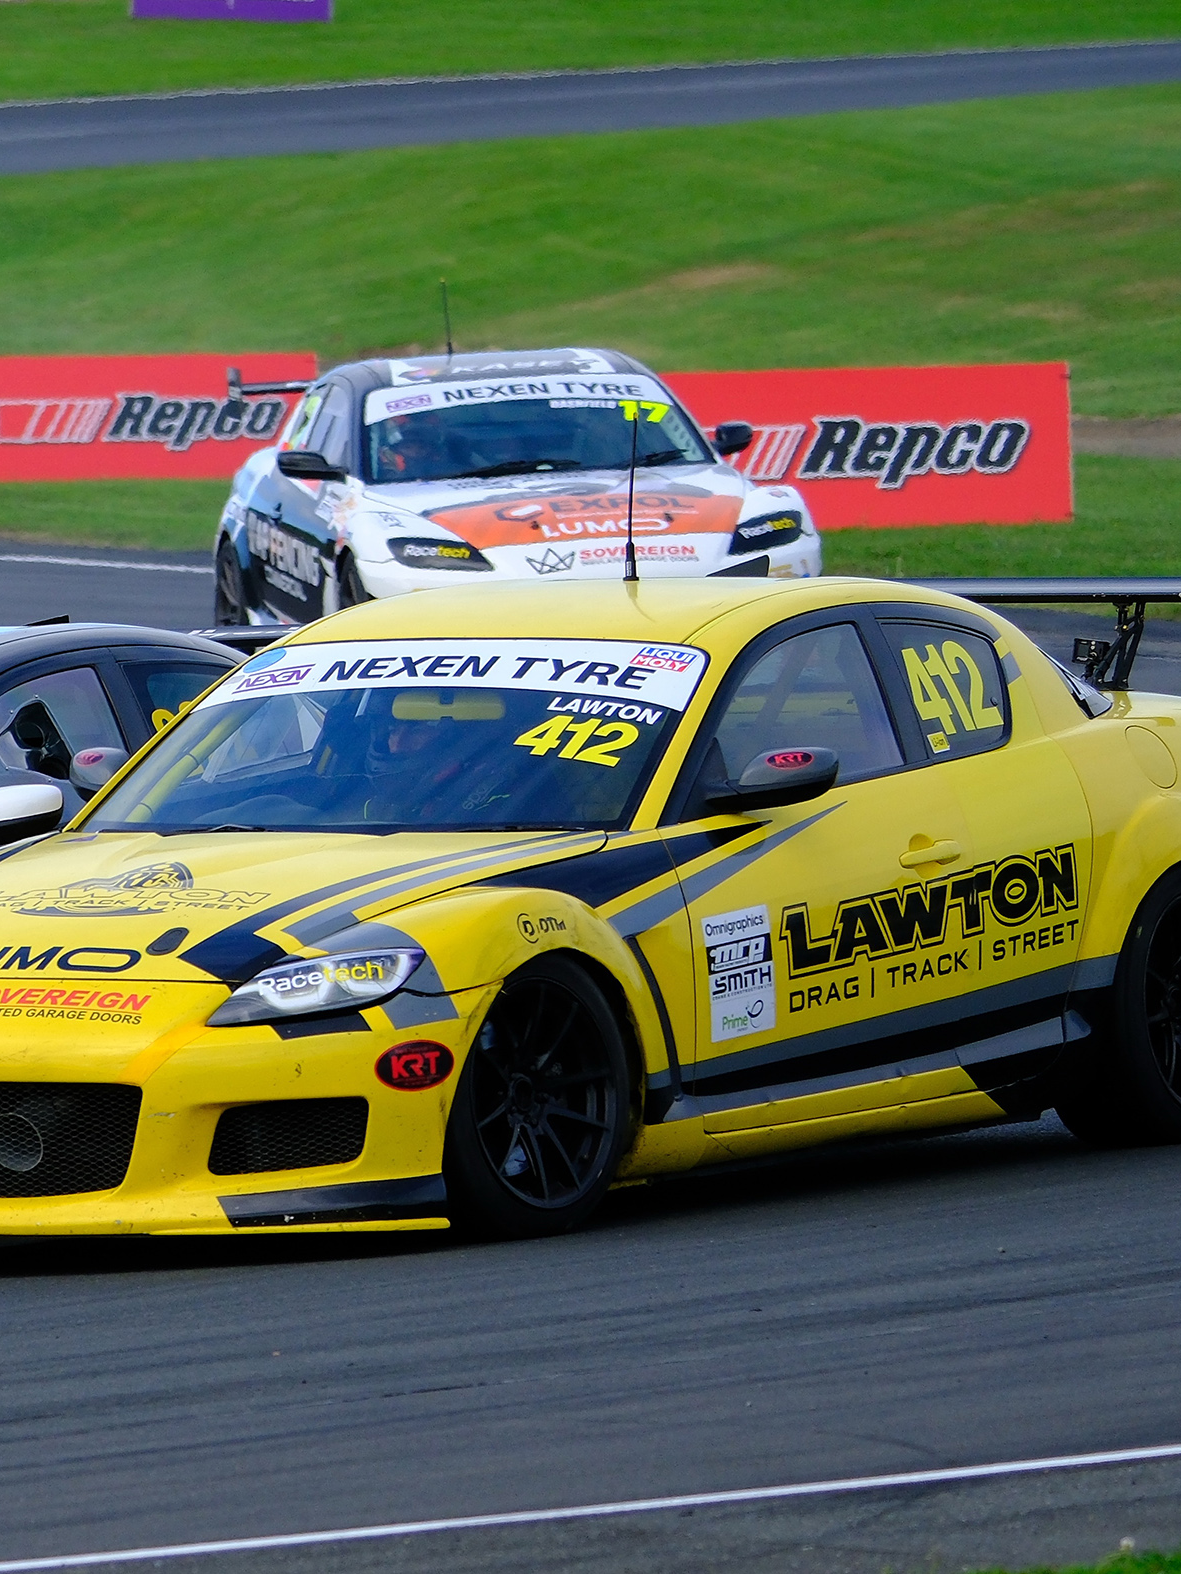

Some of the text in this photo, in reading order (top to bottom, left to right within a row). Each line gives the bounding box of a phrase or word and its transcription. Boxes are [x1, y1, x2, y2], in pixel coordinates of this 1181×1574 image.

[443, 382, 644, 402] NEXEN TYRE
[617, 400, 670, 424] 17
[797, 415, 1031, 489] Repco
[541, 518, 669, 538] LUMO
[633, 656, 688, 671] MOLY
[641, 646, 694, 663] LIQUI
[234, 666, 314, 692] NEXEN
[320, 655, 656, 690] NEXEN TYRE
[901, 640, 1004, 735] 412
[547, 697, 663, 725] LAWTON
[513, 715, 639, 767] 412
[774, 753, 804, 764] KRT
[154, 900, 251, 911] STREET
[778, 843, 1079, 981] LAWTON
[705, 914, 764, 936] Omnigraphics
[258, 961, 384, 995] Racetech
[789, 919, 1081, 1013] DRAG TRACK STREET
[25, 1008, 87, 1020] GARAGE
[89, 1012, 143, 1025] DOORS
[722, 1013, 749, 1031] Prime
[390, 1050, 440, 1079] KRT
